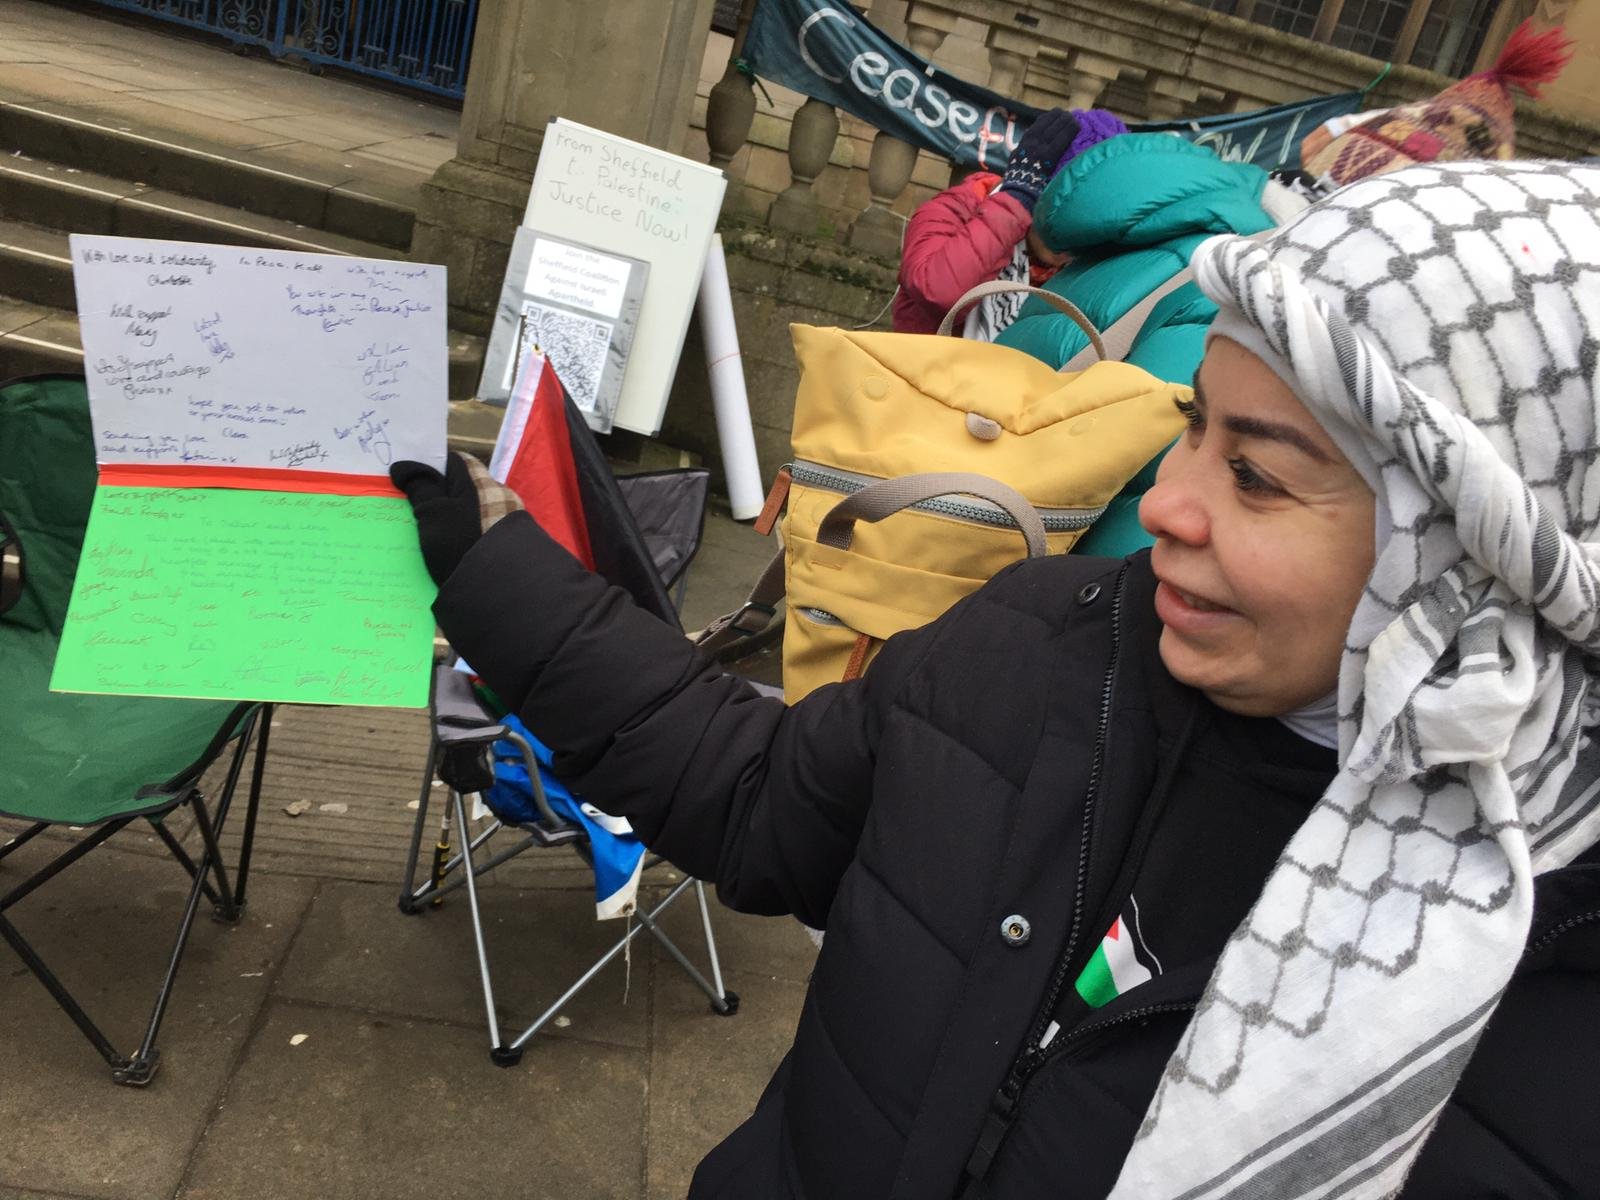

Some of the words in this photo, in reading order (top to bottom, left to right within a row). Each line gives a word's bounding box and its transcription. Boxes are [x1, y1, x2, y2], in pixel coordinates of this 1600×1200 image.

[798, 8, 1021, 170] Ceasefi
[600, 145, 683, 191] Sheffield
[549, 180, 623, 222] Justice
[636, 209, 688, 242] Now!
[133, 252, 155, 265] and
[538, 256, 578, 273] Sheffield
[579, 268, 620, 286] Coalition
[544, 273, 578, 289] Against
